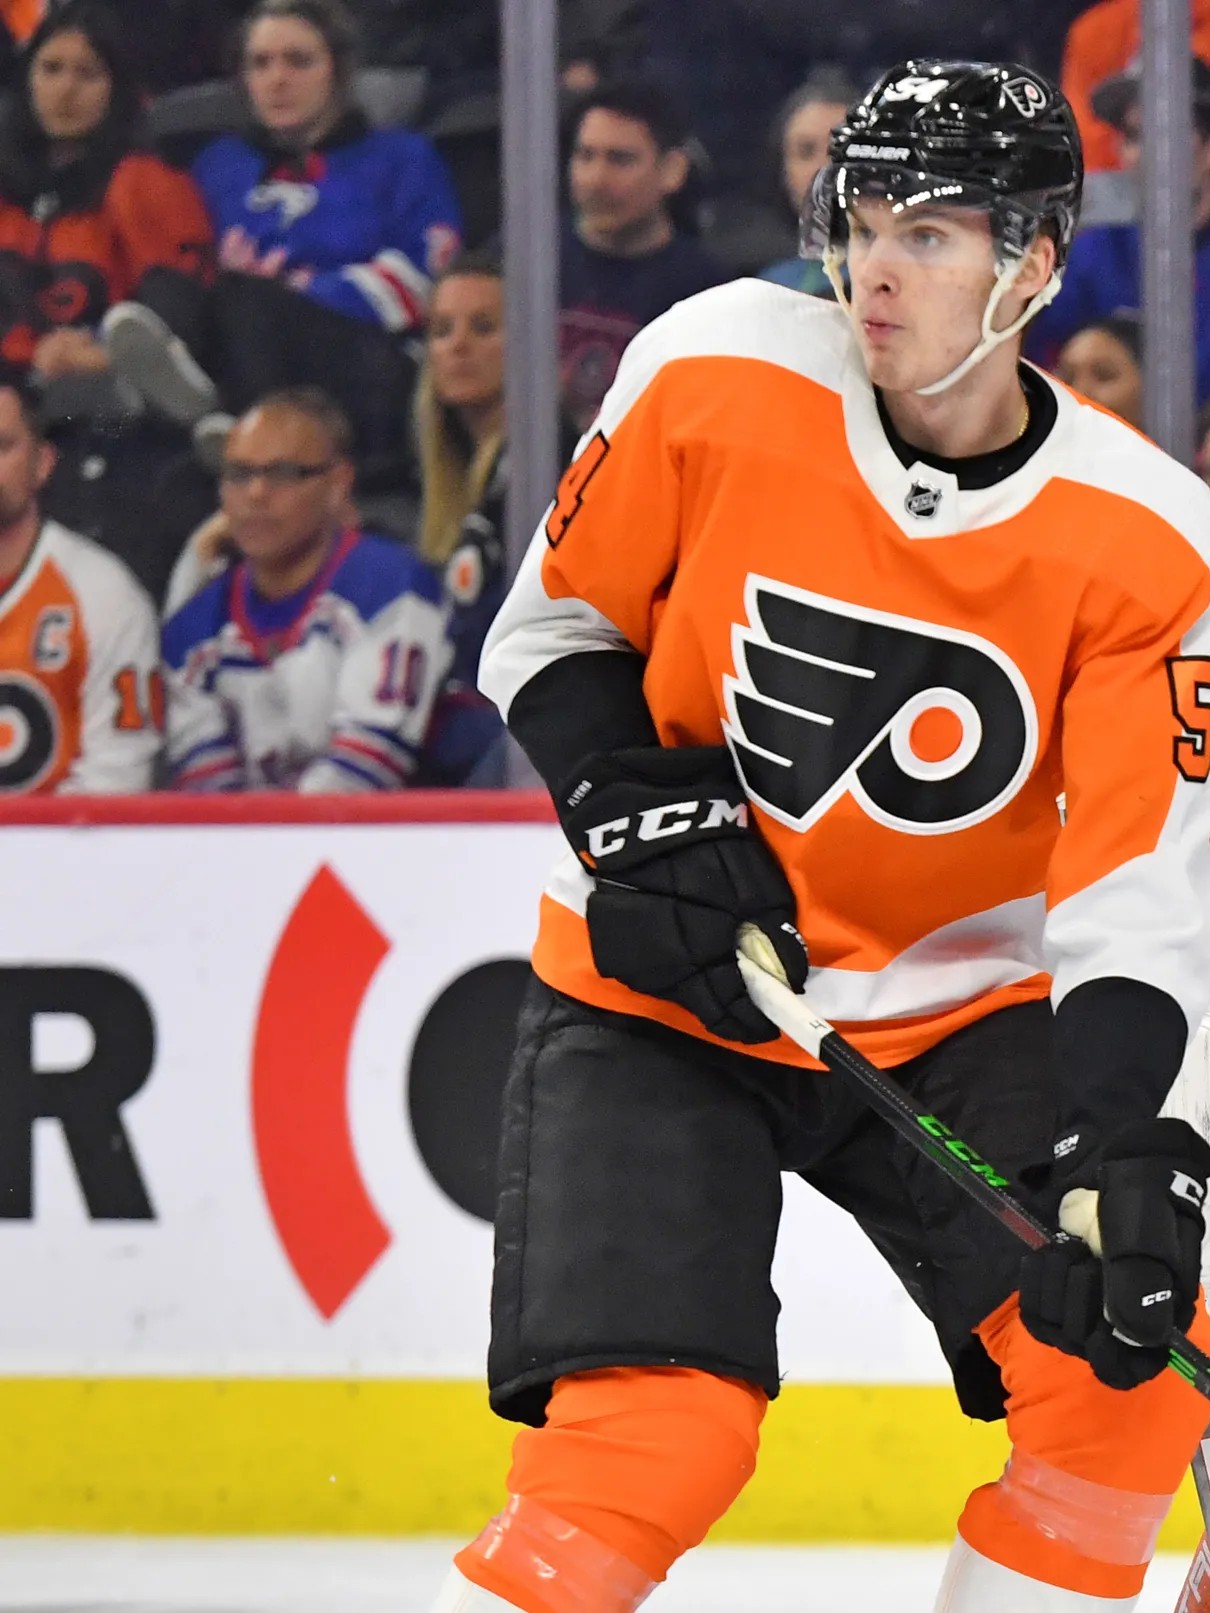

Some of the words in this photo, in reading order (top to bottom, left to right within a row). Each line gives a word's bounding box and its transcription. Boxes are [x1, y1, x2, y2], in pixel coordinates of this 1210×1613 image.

[883, 76, 950, 104] 54
[846, 143, 911, 161] BAUER
[545, 428, 610, 551] 4
[31, 605, 73, 672] C
[584, 799, 748, 858] CCM
[0, 963, 158, 1221] R
[916, 1114, 1010, 1187] CCM
[1053, 1134, 1079, 1155] CCM
[1141, 1289, 1172, 1307] CC
